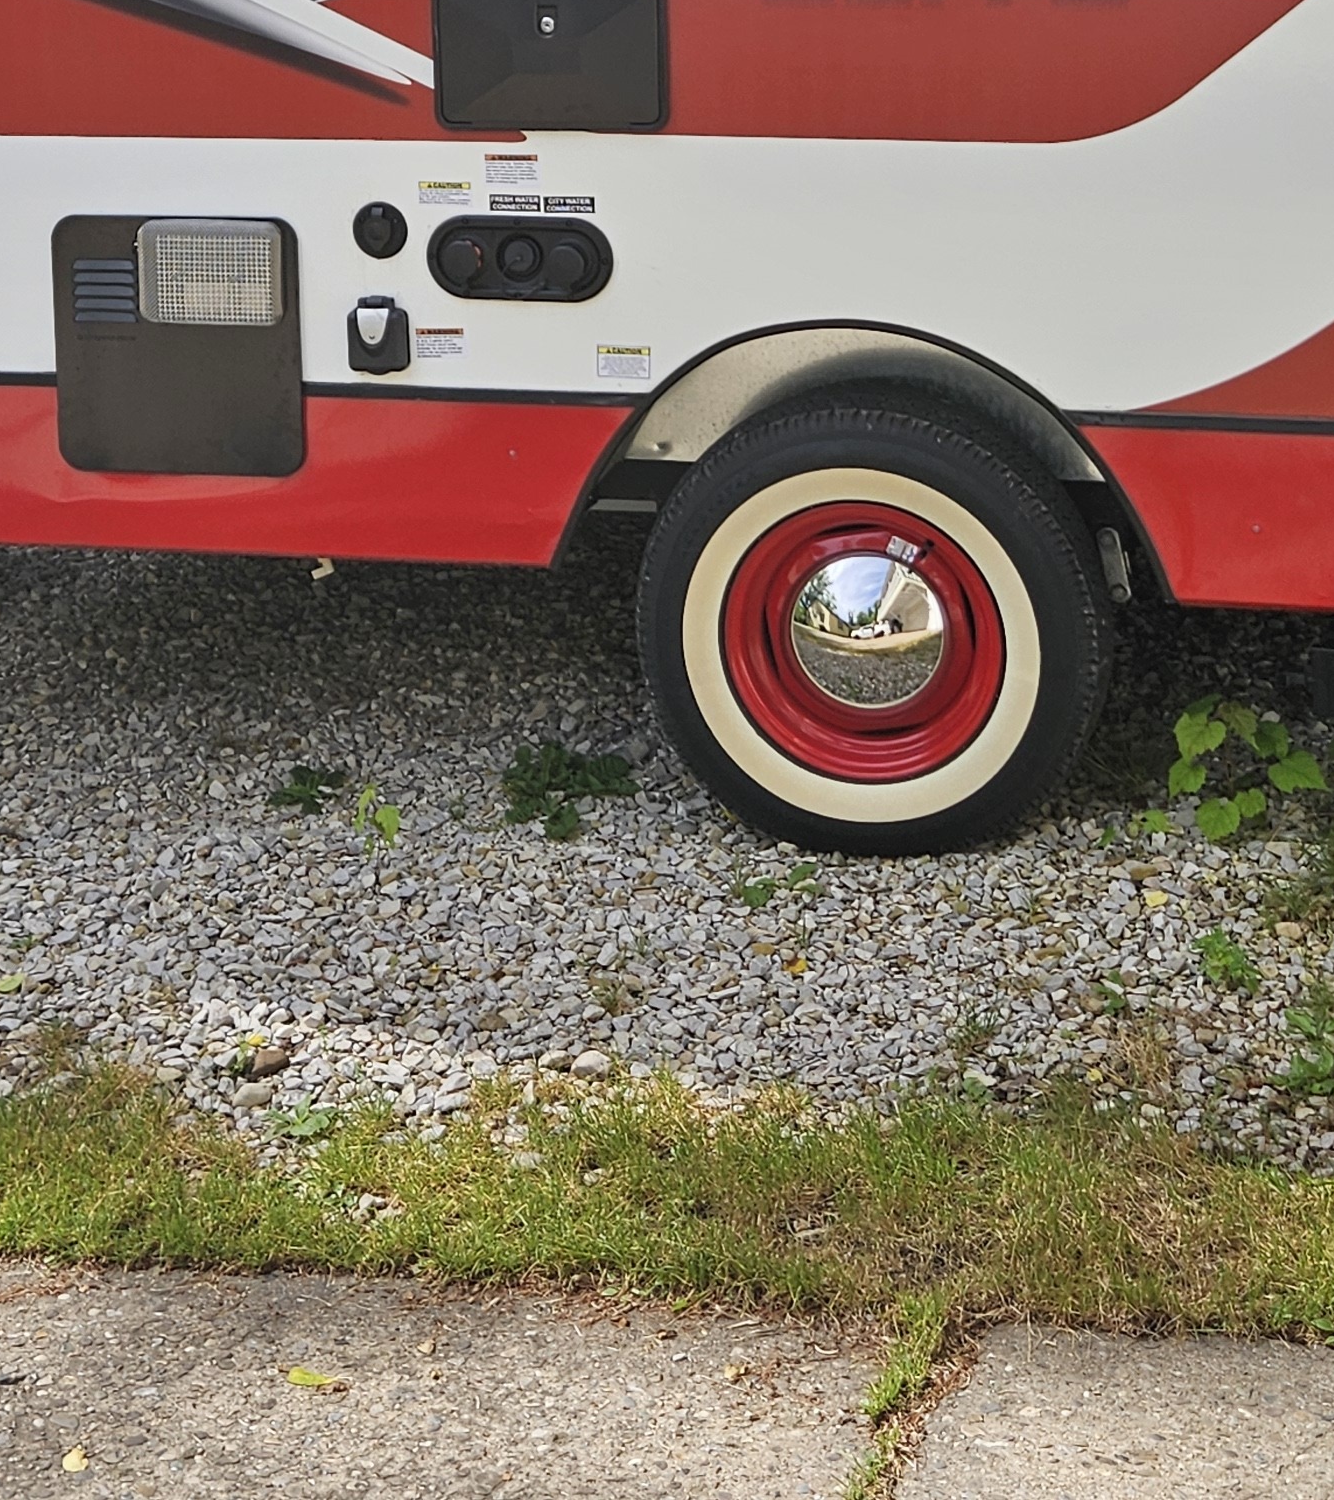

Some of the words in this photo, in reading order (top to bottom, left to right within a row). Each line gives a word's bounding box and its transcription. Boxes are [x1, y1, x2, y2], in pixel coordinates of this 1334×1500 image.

[490, 195, 514, 203] FRESH
[515, 196, 539, 204] WATER
[547, 197, 565, 205] CITY
[492, 203, 538, 211] CONNECTION
